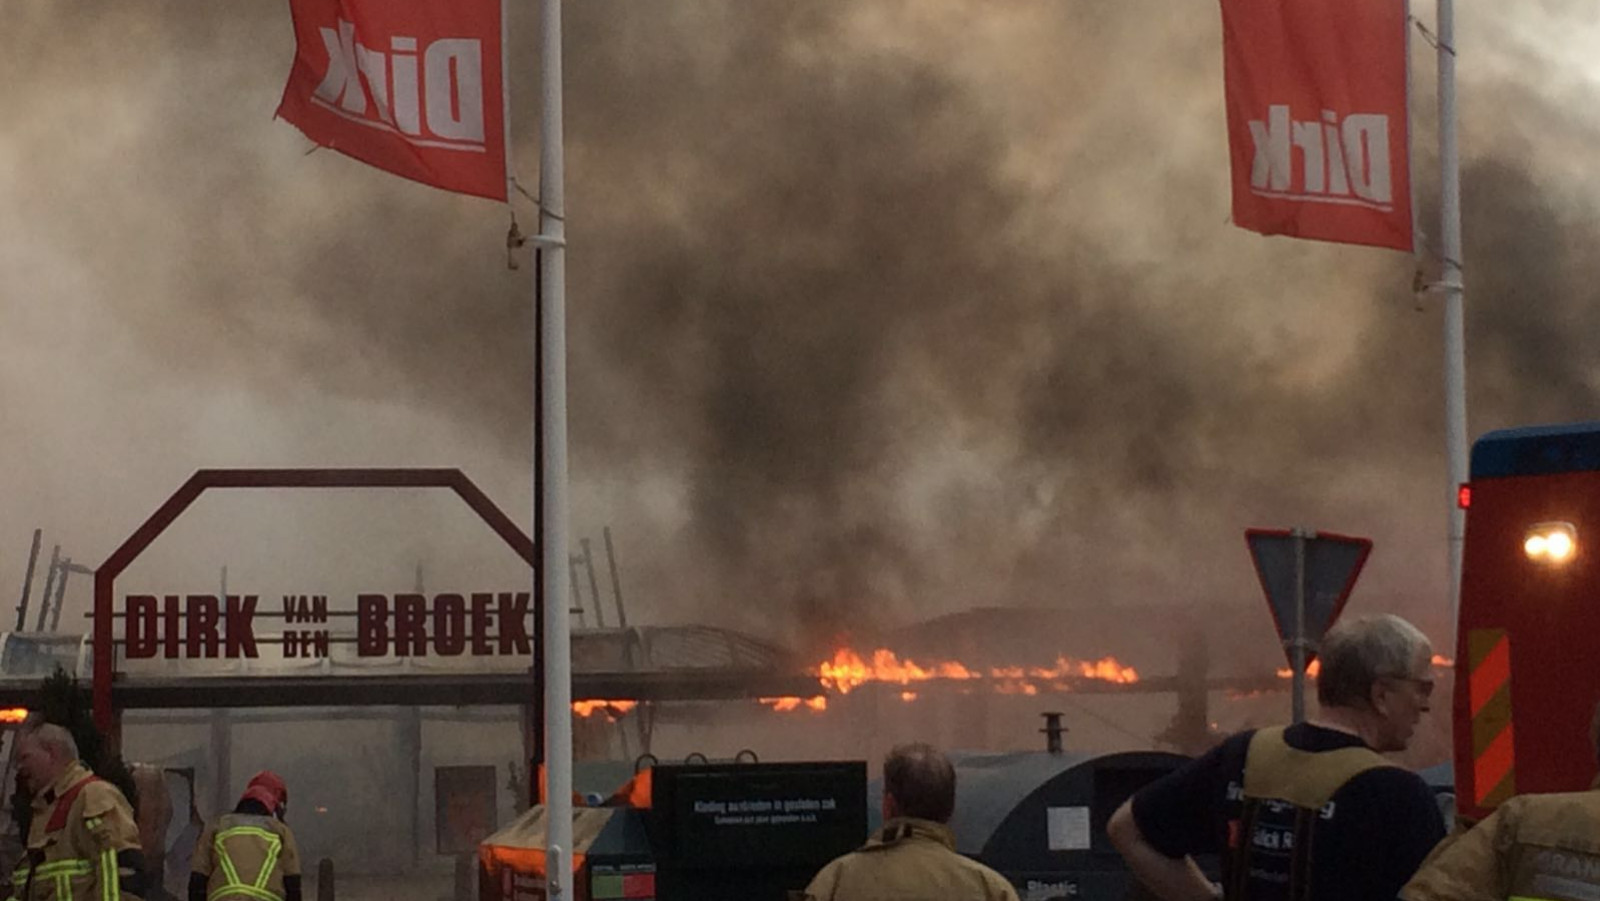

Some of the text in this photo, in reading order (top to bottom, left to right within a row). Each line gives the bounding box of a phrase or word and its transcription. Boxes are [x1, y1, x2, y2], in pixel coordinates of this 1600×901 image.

[125, 592, 532, 659] DIRK VAN DEN BROEK
